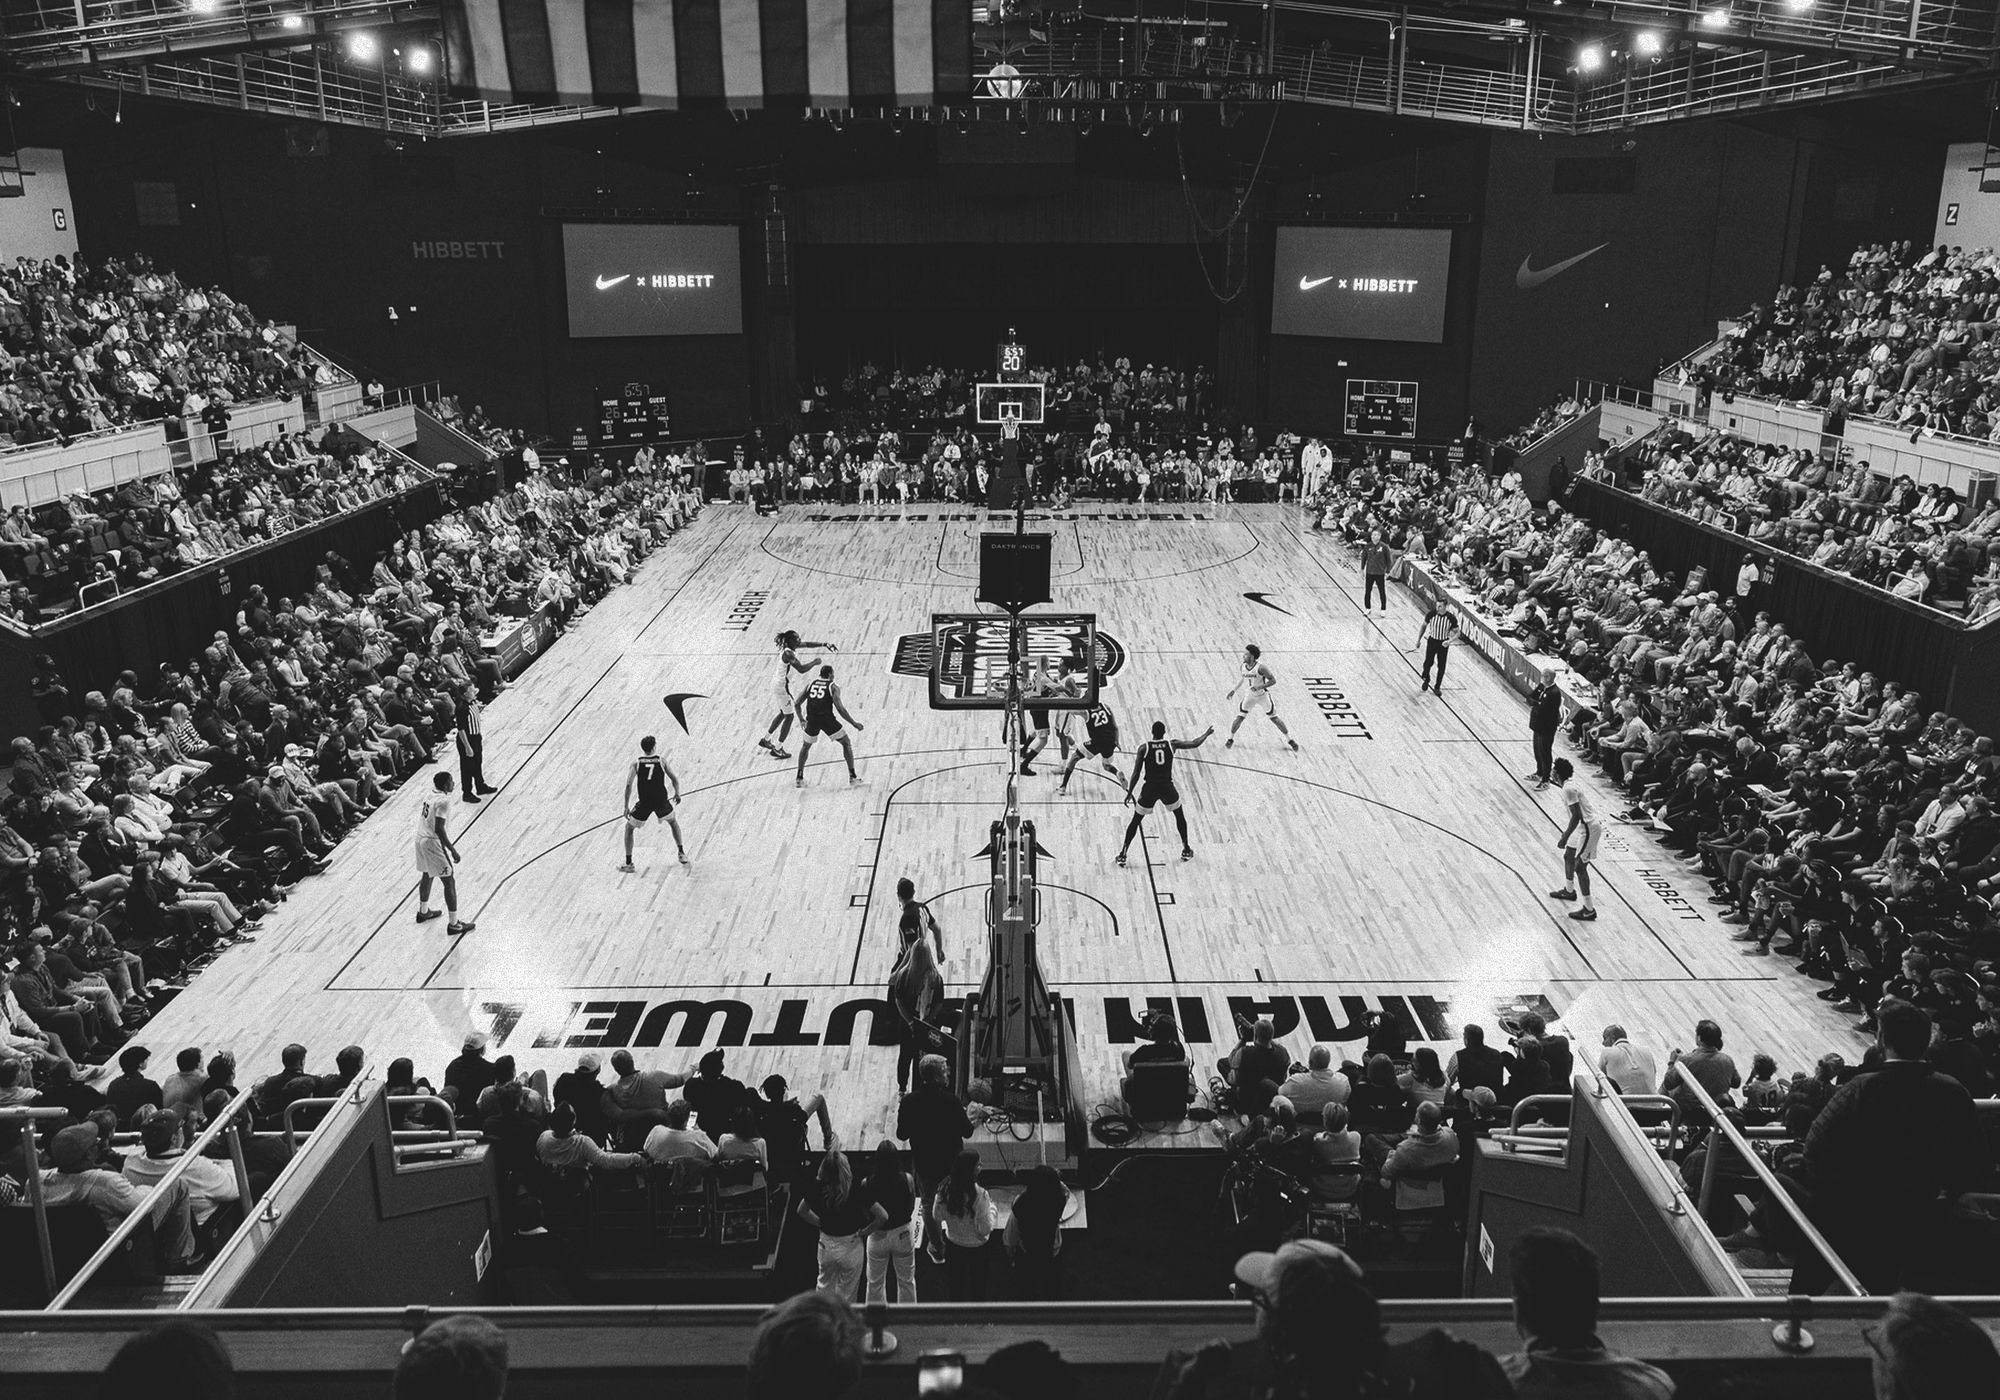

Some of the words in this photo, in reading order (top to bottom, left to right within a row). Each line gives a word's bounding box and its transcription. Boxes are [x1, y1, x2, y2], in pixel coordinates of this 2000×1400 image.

[54, 211, 65, 228] G
[1947, 206, 1958, 223] Z
[412, 241, 505, 258] HIBBETT
[652, 275, 714, 288] HIBBETT
[1353, 278, 1418, 293] HIBBETT
[1004, 347, 1023, 356] 6:57
[1002, 356, 1020, 371] 20
[625, 385, 650, 397] 6:57
[653, 404, 667, 416] 23
[1399, 404, 1413, 416] 23
[1762, 571, 1774, 584] 102
[220, 582, 231, 595] 107
[721, 591, 770, 631] HIBBETT
[948, 651, 963, 674] HIBBETT
[810, 685, 826, 699] 55
[1302, 678, 1373, 740] HIBBETT
[1091, 710, 1108, 727] 23
[1155, 750, 1165, 765] 0
[645, 764, 655, 780] 7
[1634, 869, 1706, 922] HIBBETT
